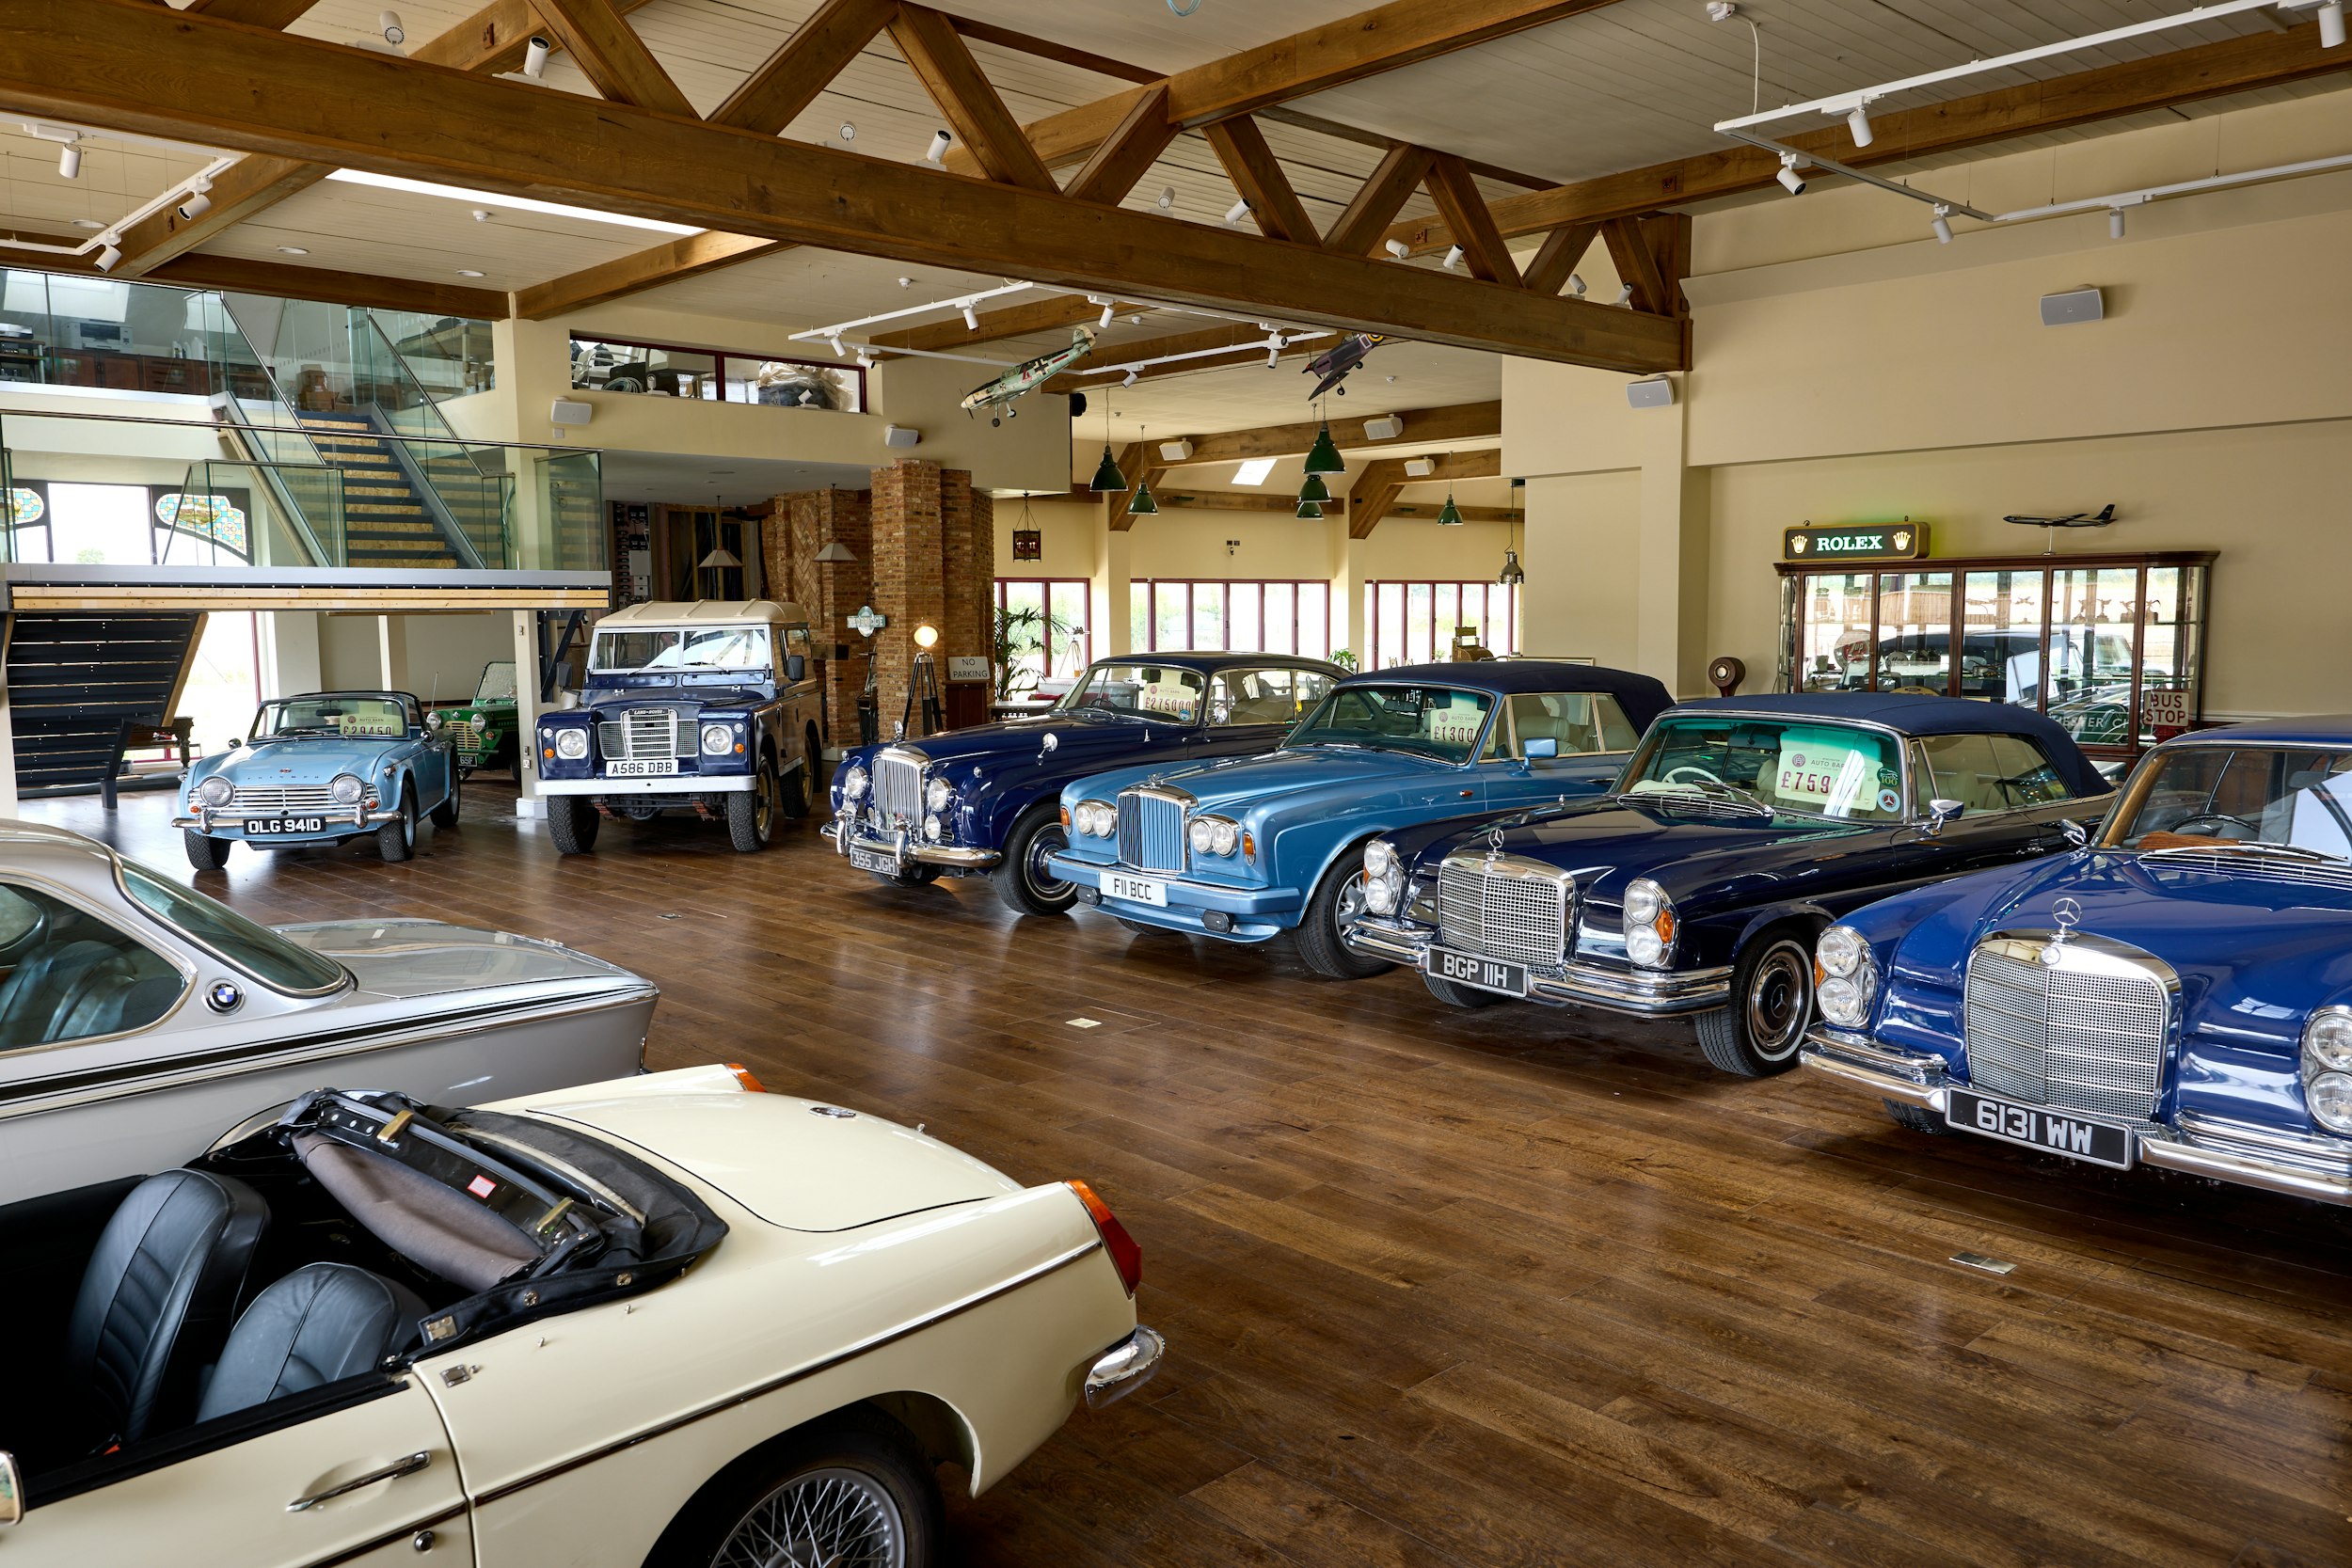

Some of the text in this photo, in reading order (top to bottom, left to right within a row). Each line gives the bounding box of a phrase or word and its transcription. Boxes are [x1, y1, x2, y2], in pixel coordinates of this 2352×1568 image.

[1816, 534, 1883, 552] ROLEX
[953, 670, 988, 678] PARKING
[2150, 693, 2183, 707] BUS
[2146, 709, 2186, 724] STOP
[343, 725, 391, 735] £29450
[1434, 725, 1475, 743] £1300
[612, 762, 673, 775] A586 DBB
[1811, 759, 1830, 768] AUTO
[1781, 770, 1832, 794] £759
[247, 818, 322, 834] OLG 941D
[852, 850, 896, 873] 355 JGH
[1114, 878, 1152, 900] F11 BCC
[1443, 953, 1507, 988] BGP 11H
[1977, 1100, 2092, 1155] 6131 WW
